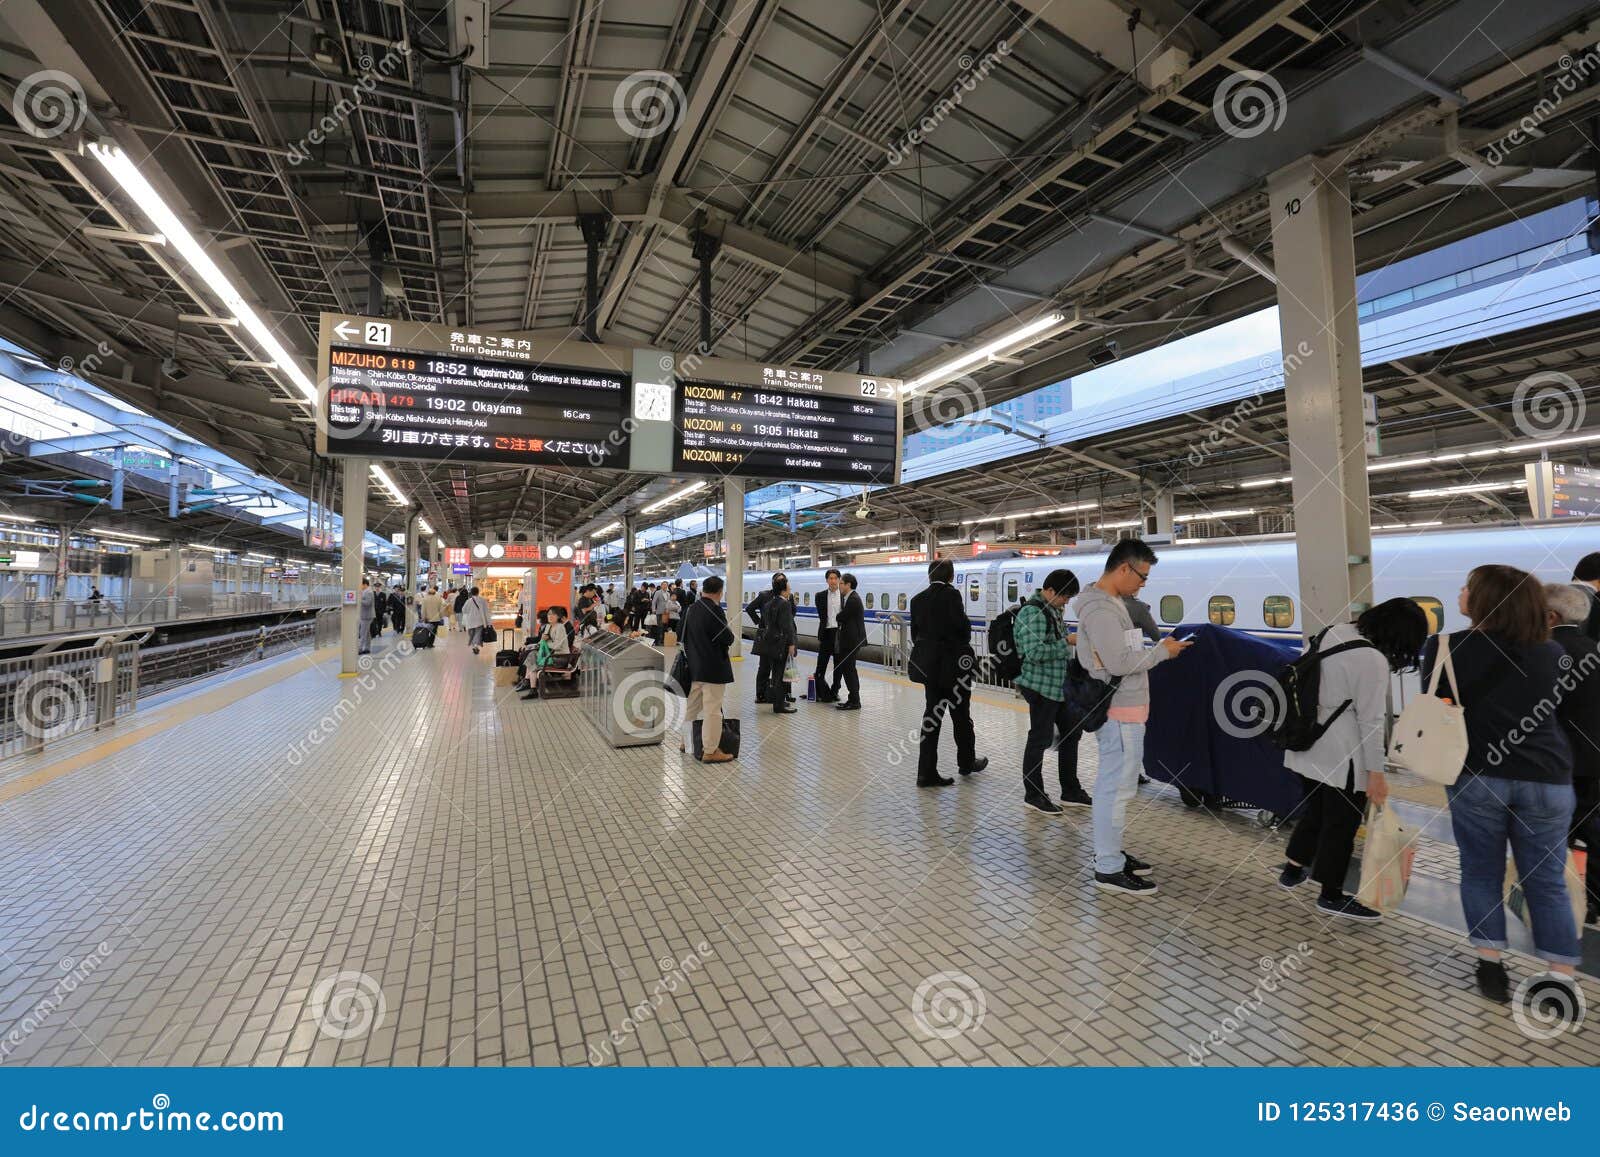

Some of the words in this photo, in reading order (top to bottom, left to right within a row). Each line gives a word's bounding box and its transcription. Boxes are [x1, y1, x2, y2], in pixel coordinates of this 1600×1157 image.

[1284, 198, 1301, 217] 10
[368, 326, 388, 342] 21
[450, 332, 531, 350] 発車ご案内
[450, 344, 474, 353] Train
[478, 346, 530, 359] Departures
[332, 352, 386, 368] MIZUHO
[392, 359, 416, 370] 619
[427, 361, 467, 375] 18:52
[532, 373, 562, 384] Originating
[608, 380, 621, 389] Cars
[763, 378, 782, 386] Train
[784, 380, 822, 390] Departures
[862, 382, 876, 395] 22
[331, 389, 386, 406] HIKARI
[391, 396, 414, 406] 479
[427, 398, 465, 412] 19:02
[473, 401, 522, 415] Okayama
[573, 411, 590, 420] Cars
[685, 386, 724, 400] NOZOMI
[754, 393, 782, 406] 18:42
[787, 397, 819, 409] Hakata
[684, 419, 724, 432] NOZOMI
[730, 424, 742, 432] 49
[754, 425, 782, 436] 19:05
[786, 428, 818, 439] Hakata
[683, 449, 722, 463] NOZOMI
[726, 453, 743, 462] 241
